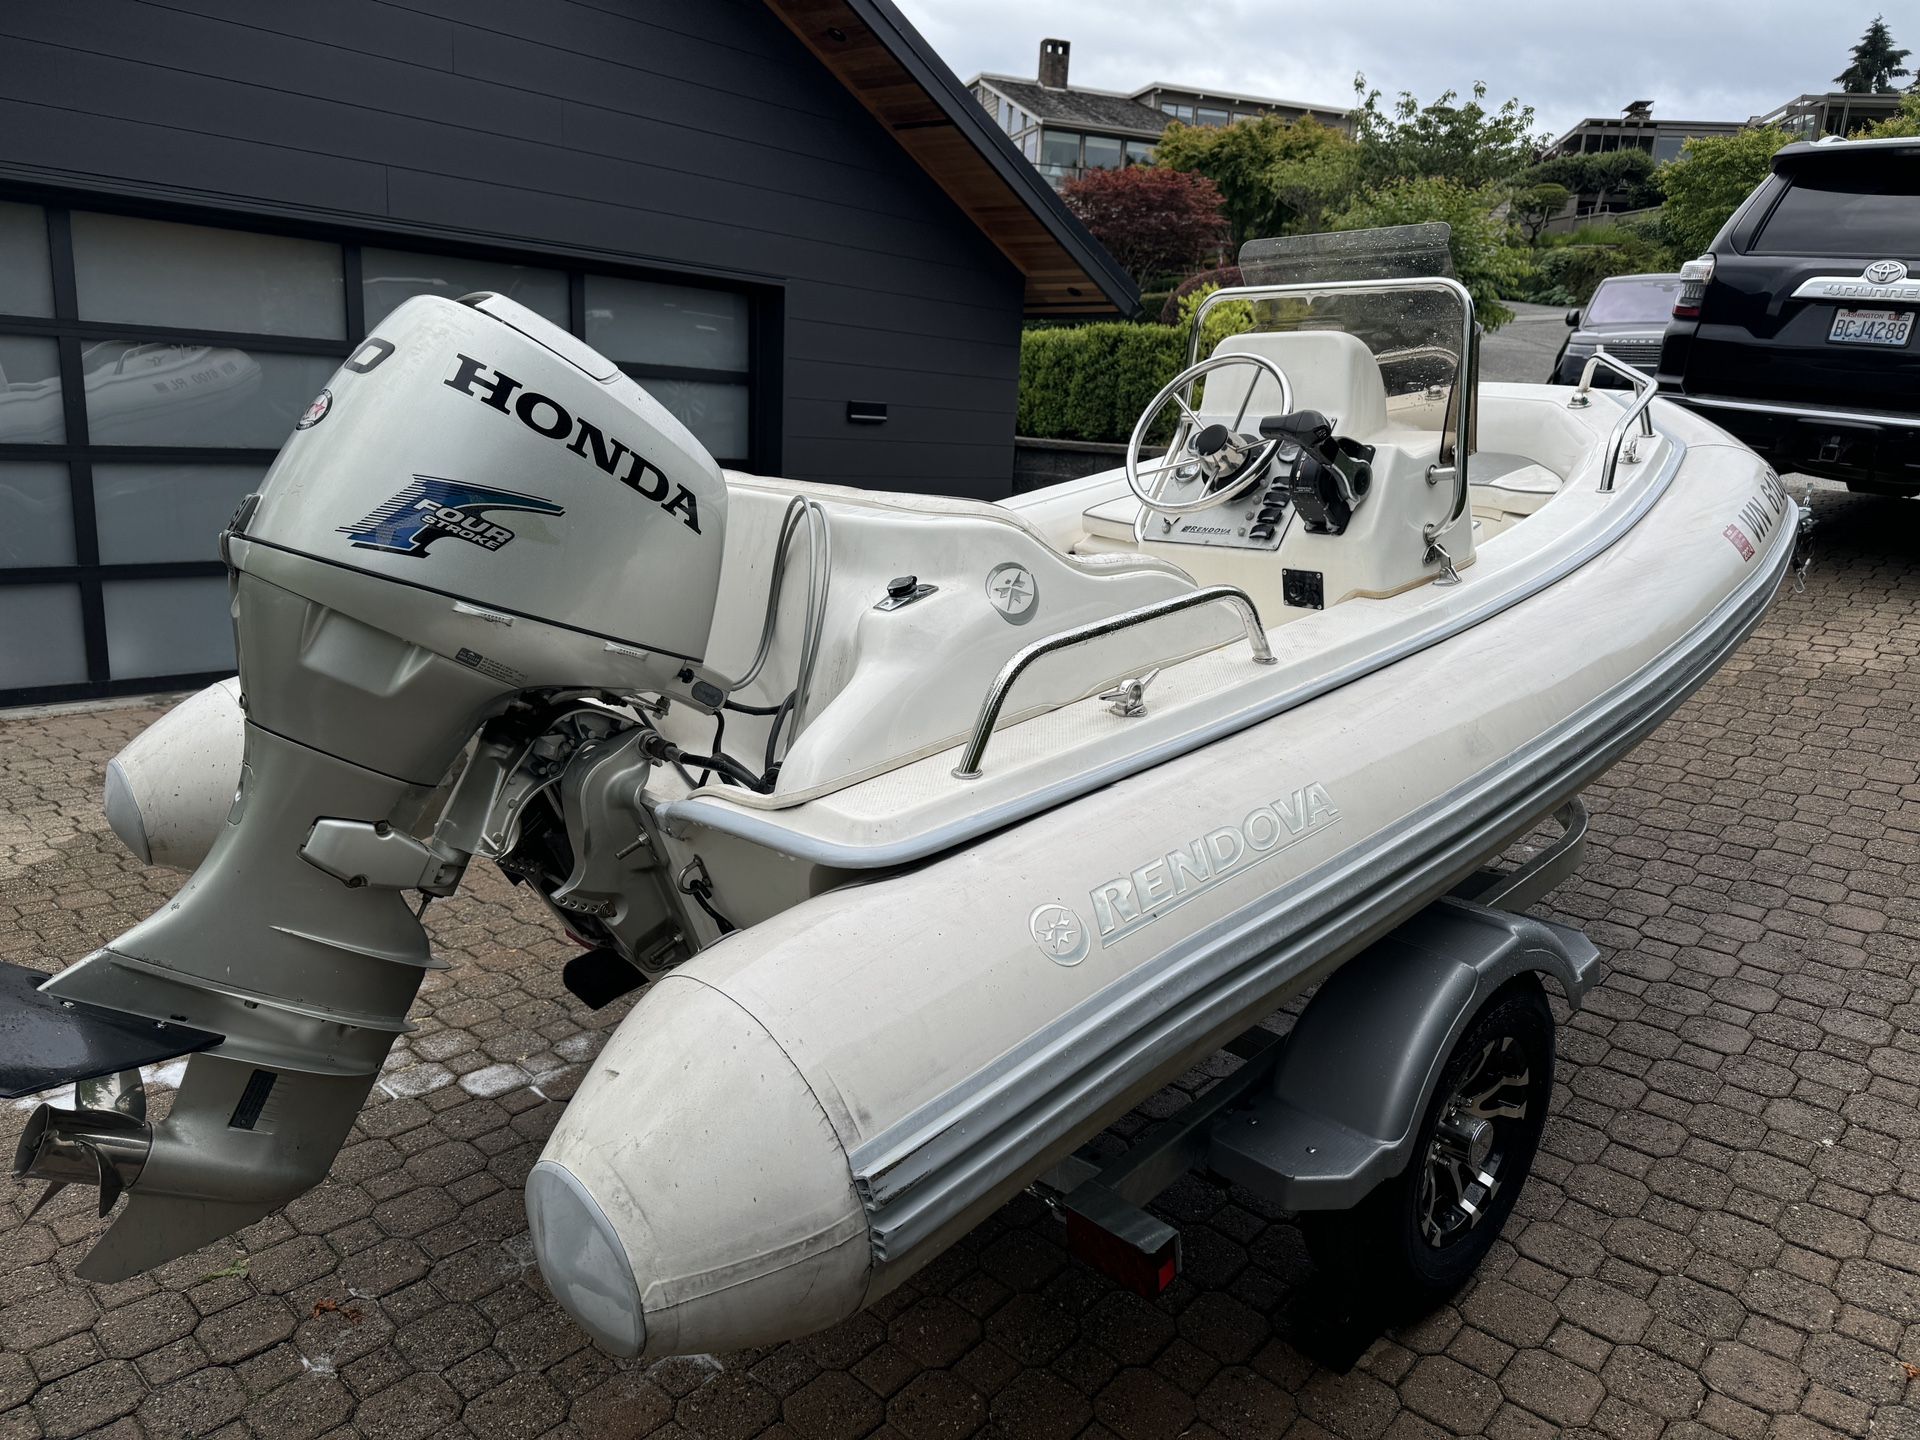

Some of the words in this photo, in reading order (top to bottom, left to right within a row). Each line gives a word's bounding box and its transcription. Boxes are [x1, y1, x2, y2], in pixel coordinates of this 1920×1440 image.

[1823, 285, 1920, 298] 4RUNNE
[1833, 319, 1908, 341] BCJ4288
[443, 352, 703, 536] HONDA
[413, 499, 513, 543] FOUR
[421, 515, 501, 550] STROKE
[1188, 525, 1231, 535] RENDOVA
[1738, 496, 1772, 543] WN
[1089, 781, 1338, 936] RENDOVA
